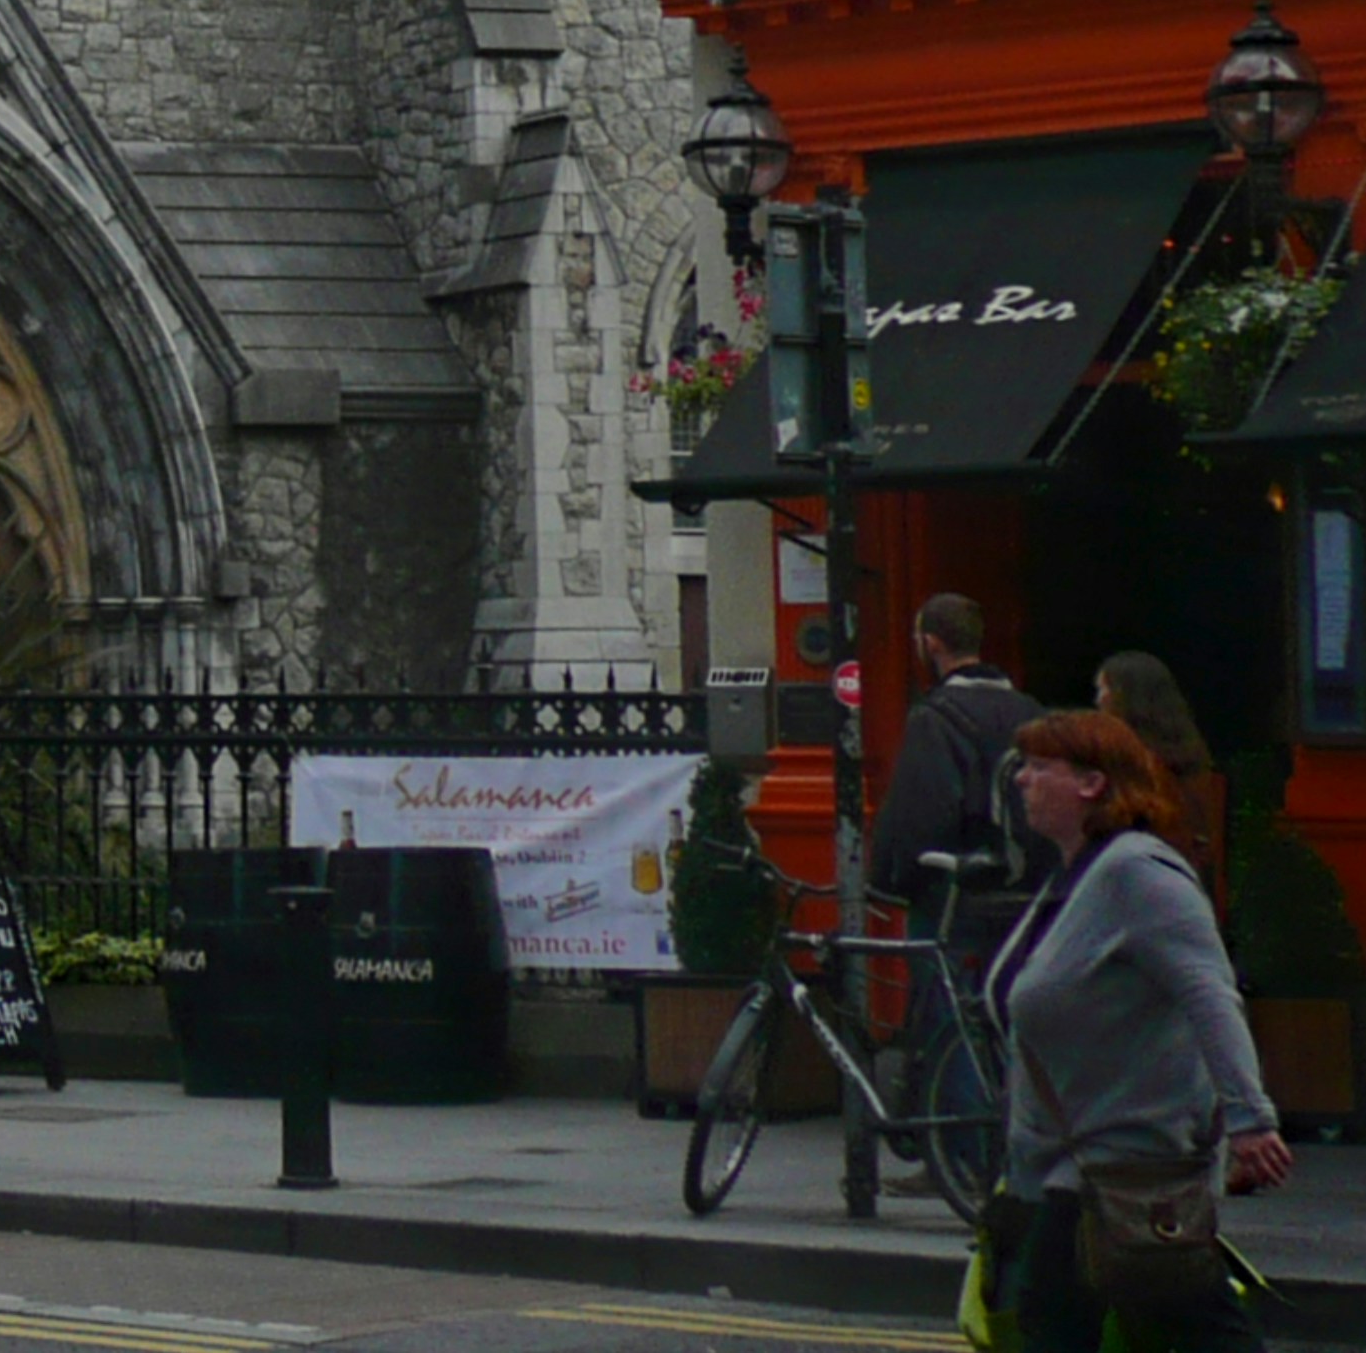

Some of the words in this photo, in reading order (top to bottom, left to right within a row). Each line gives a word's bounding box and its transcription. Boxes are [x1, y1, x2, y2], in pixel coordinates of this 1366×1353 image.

[974, 285, 1077, 325] Bar
[393, 764, 595, 810] Salamanca
[334, 958, 433, 982] SALAMANCA
